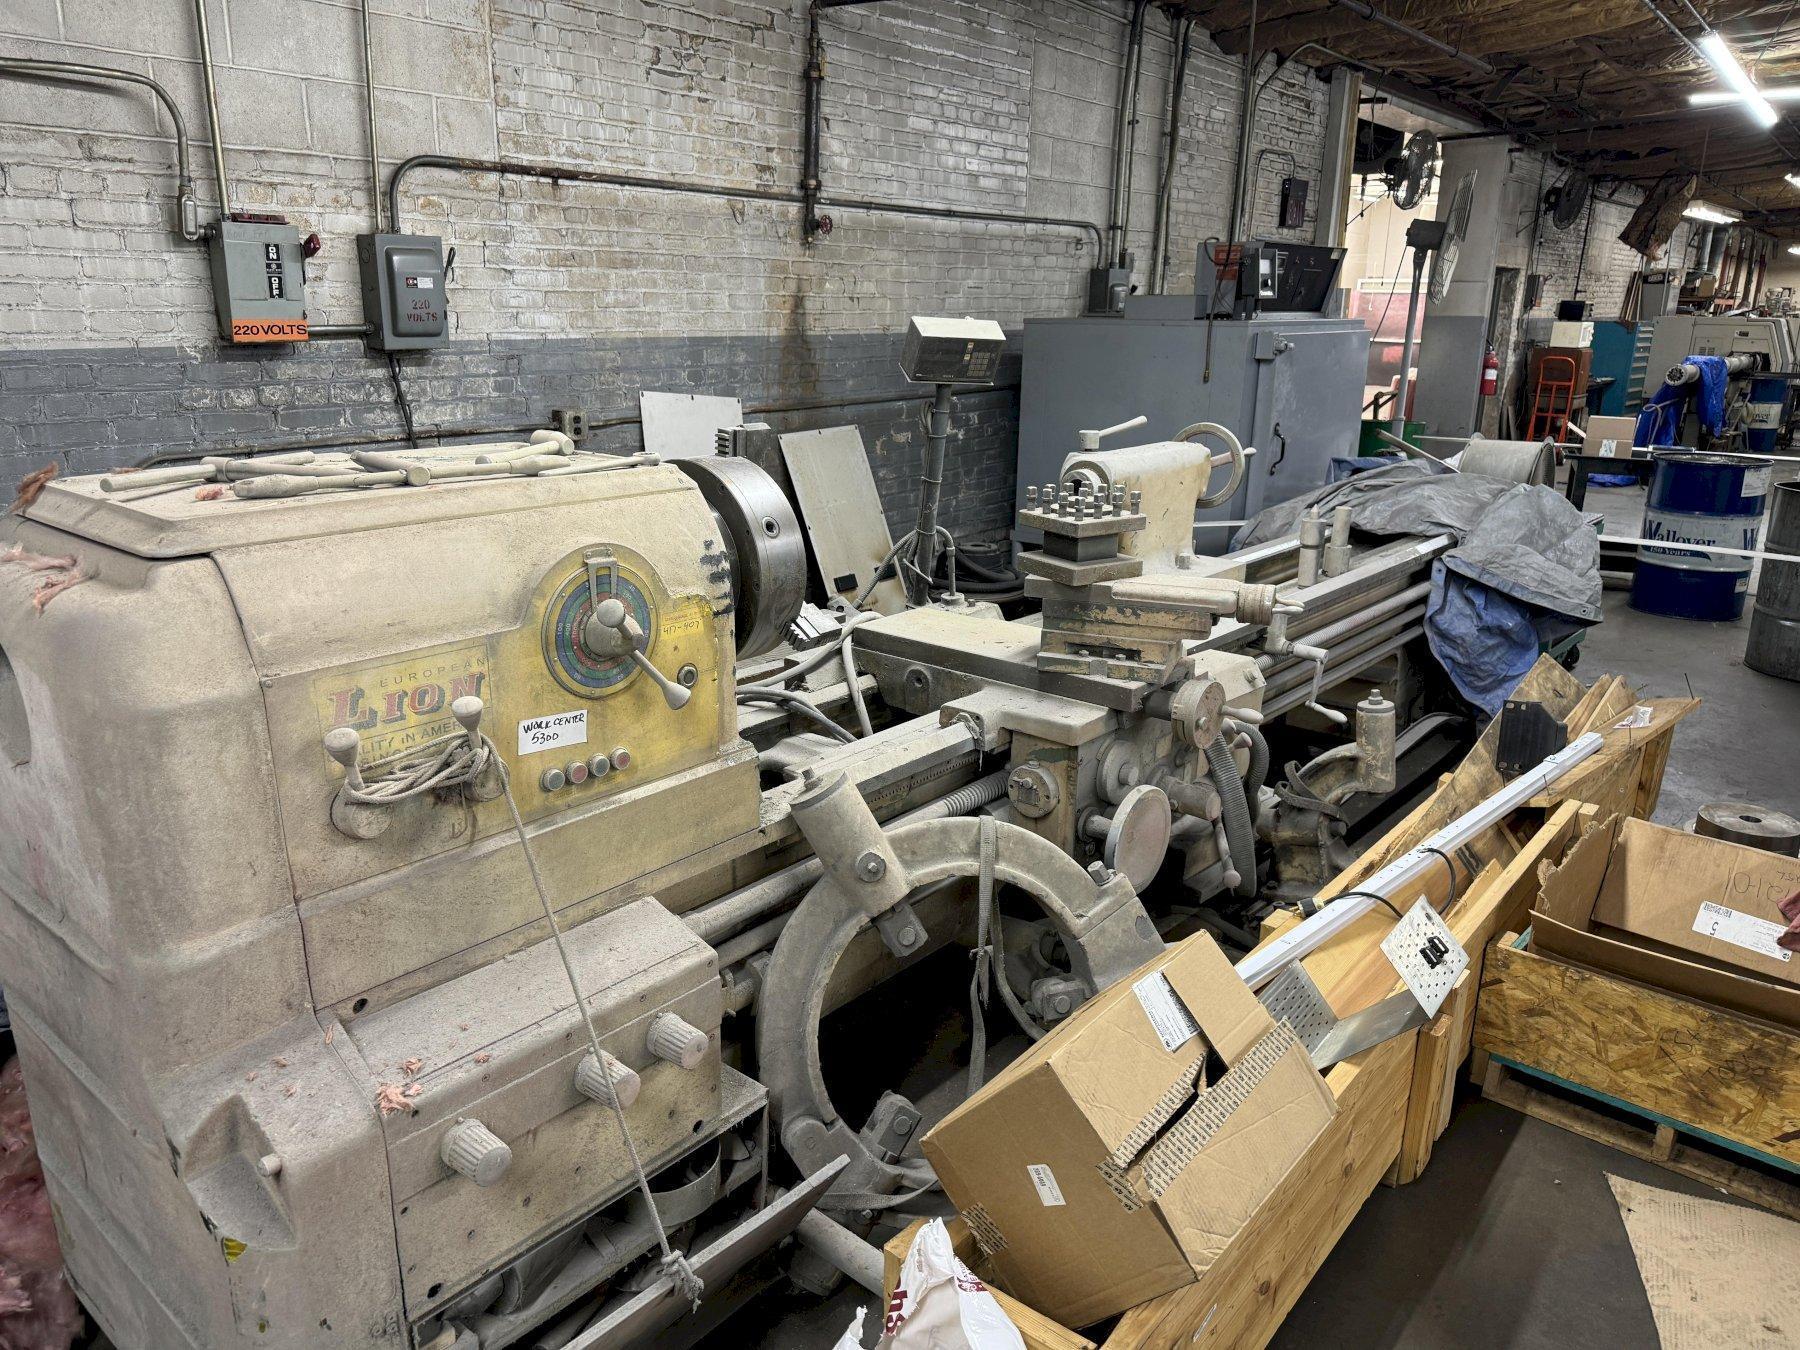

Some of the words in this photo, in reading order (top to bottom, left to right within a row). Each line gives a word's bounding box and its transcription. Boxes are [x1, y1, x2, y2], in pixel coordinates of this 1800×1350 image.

[268, 246, 277, 260] ON
[271, 277, 280, 296] OFF
[411, 299, 431, 310] 220
[406, 312, 438, 322] VOLTS
[233, 325, 259, 335] 220
[260, 324, 307, 335] VOLTS
[379, 656, 488, 688] EUROPEAN
[328, 671, 487, 732] LION
[523, 720, 552, 734] WORK
[553, 712, 586, 726] CENTER
[531, 730, 560, 744] 5300
